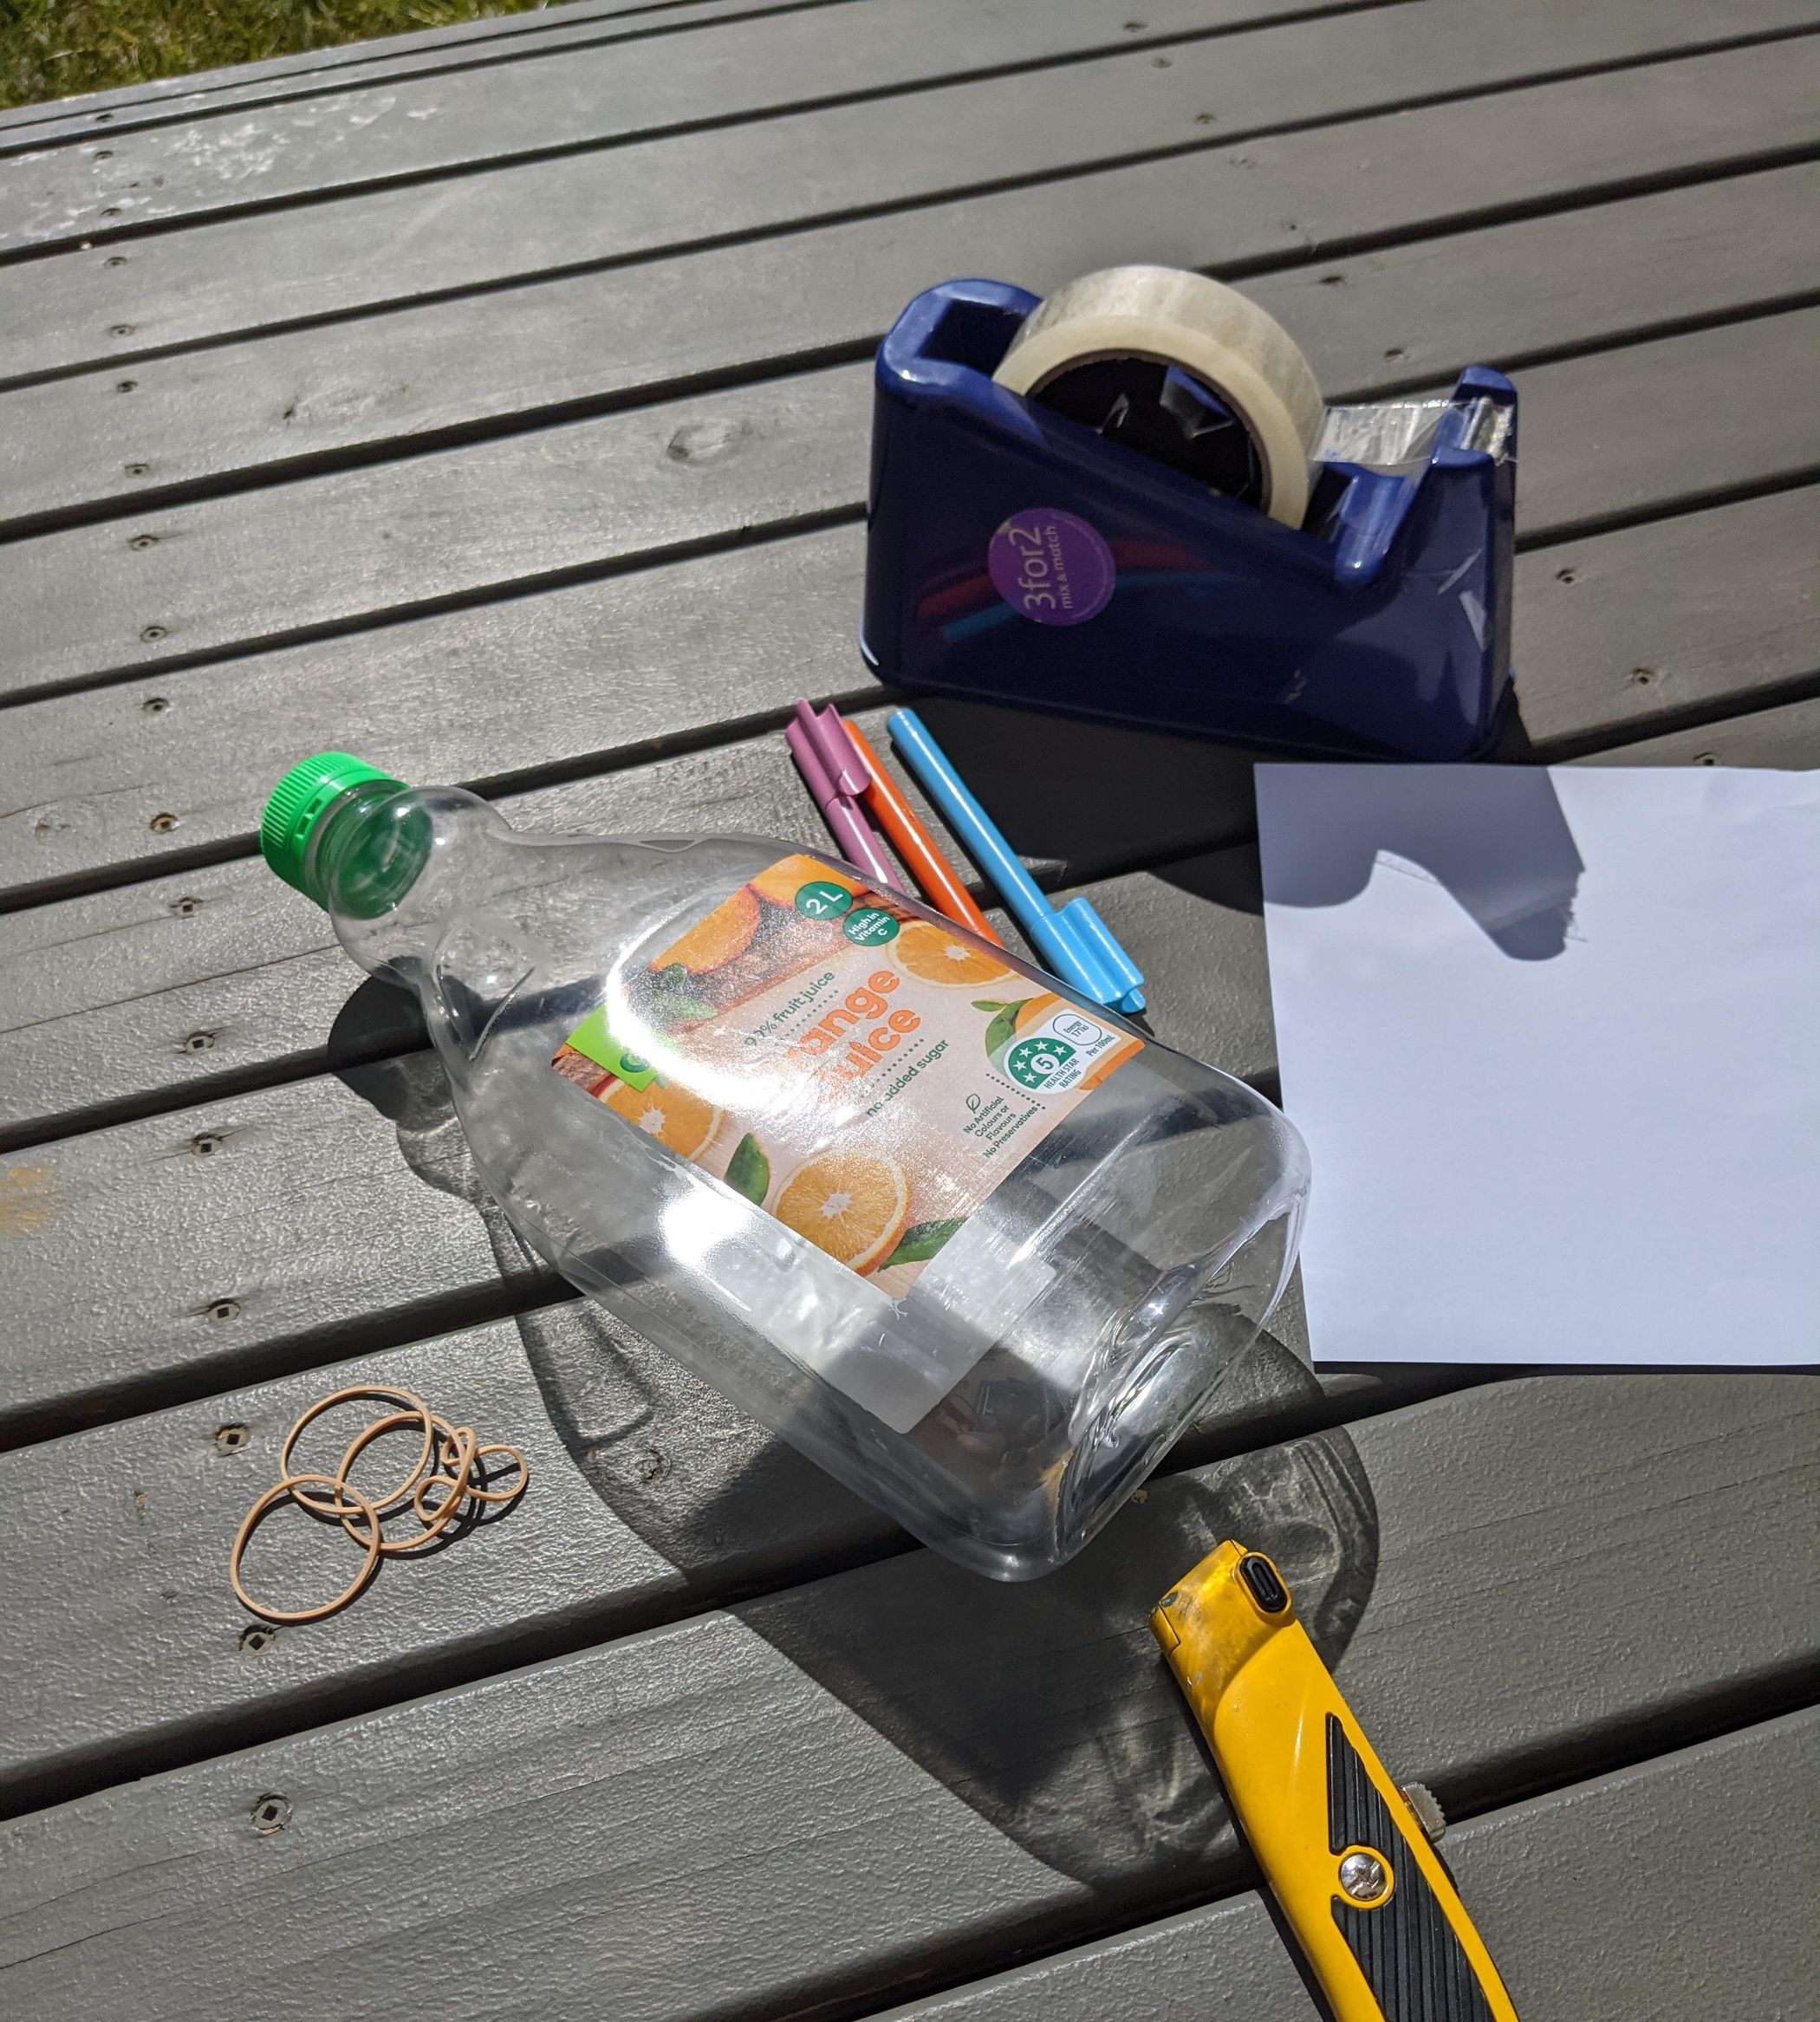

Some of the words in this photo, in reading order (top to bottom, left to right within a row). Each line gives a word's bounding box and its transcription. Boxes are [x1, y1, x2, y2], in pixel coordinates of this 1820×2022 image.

[1045, 525, 1064, 570] match
[1009, 527, 1056, 609] 3for2
[1058, 584, 1073, 609] mix
[848, 914, 870, 935] High
[855, 916, 890, 941] Vitamin
[772, 997, 807, 1024] fruit
[799, 972, 835, 1004] juice
[1063, 1020, 1082, 1034] Energy
[916, 1039, 949, 1070] sugar
[1035, 1057, 1054, 1070] 5
[1086, 1047, 1098, 1057] Per
[1043, 1068, 1067, 1089] HEALTH
[1063, 1058, 1080, 1071] STAR
[1058, 1070, 1082, 1089] RATING
[963, 1122, 977, 1134] No
[974, 1096, 1004, 1125] Artificial
[974, 1112, 1003, 1137] Colours
[1000, 1105, 1010, 1114] or
[985, 1113, 1017, 1141] Flavours
[983, 1146, 997, 1158] No
[993, 1106, 1038, 1148] Preservatives
